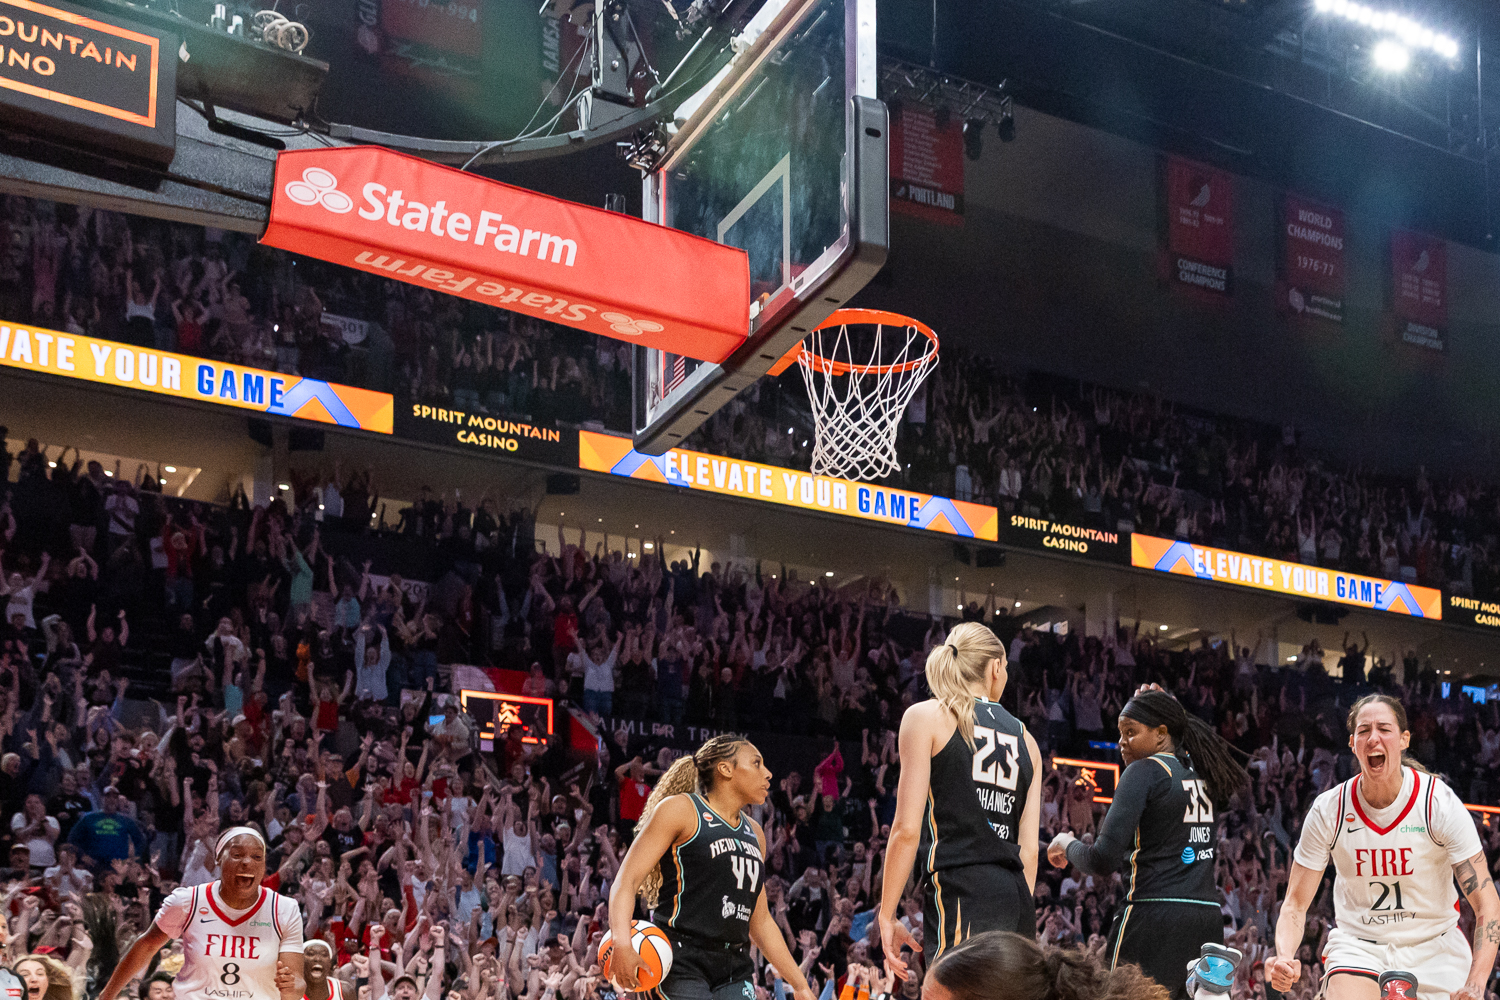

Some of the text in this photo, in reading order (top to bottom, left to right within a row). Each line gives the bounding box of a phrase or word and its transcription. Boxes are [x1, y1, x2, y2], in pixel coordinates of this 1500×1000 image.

[1298, 209, 1332, 230] WORLD
[1287, 224, 1343, 250] CHAMPIONS
[90, 343, 181, 390] YOUR
[197, 364, 285, 409] GAME
[412, 404, 560, 443] SPIRIT MOUNTAIN
[457, 430, 519, 453] CASINO
[665, 450, 921, 522] ELEVATE YOUR GAME
[1010, 514, 1119, 545] SPIRIT MOUNTAIN
[1043, 535, 1089, 554] CASINO
[1193, 548, 1383, 605] ELEVATE YOUR GAME
[1450, 596, 1479, 612] SPIRIT
[599, 716, 675, 739] AIMLER
[972, 724, 1019, 791] 23
[1181, 779, 1214, 823] 35
[1188, 826, 1211, 843] JONES
[1400, 825, 1425, 833] chime
[709, 838, 736, 859] NEW
[730, 855, 760, 892] 44
[1355, 847, 1414, 877] FIRE
[1369, 881, 1405, 911] 21
[1361, 911, 1416, 925] LASHIFY
[204, 933, 261, 960] FIRE
[220, 962, 240, 986] 8
[204, 986, 254, 998] LASHIFY
